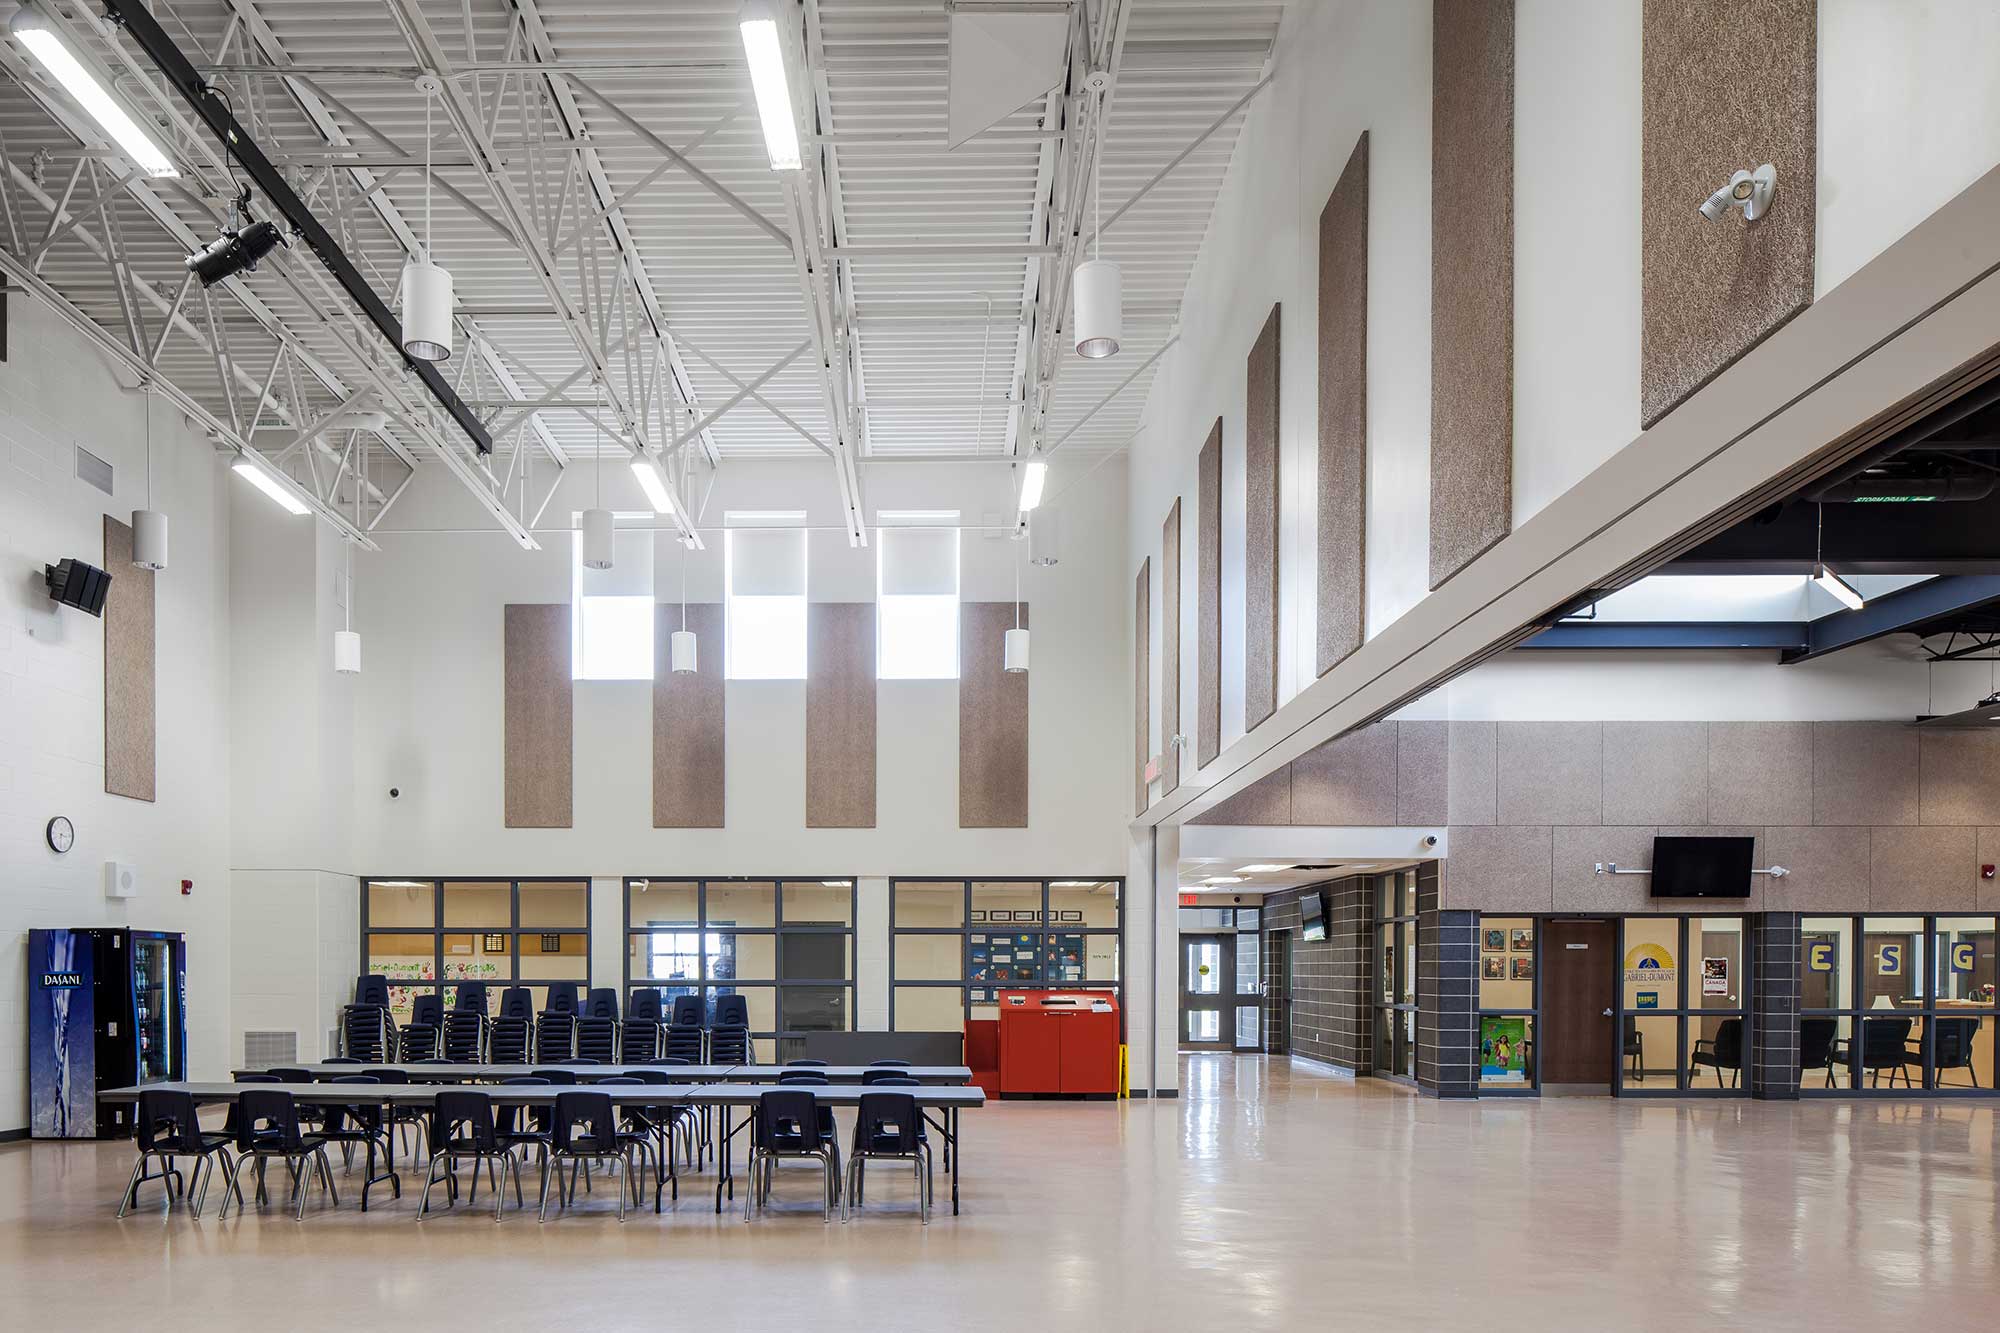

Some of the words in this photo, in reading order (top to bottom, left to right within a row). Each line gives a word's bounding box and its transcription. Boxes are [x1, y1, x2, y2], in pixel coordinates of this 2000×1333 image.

[1183, 895, 1197, 905] EXIT
[1811, 944, 1832, 970] E
[1881, 946, 1899, 972] S
[1953, 944, 1974, 970] G
[44, 974, 80, 986] DASANI
